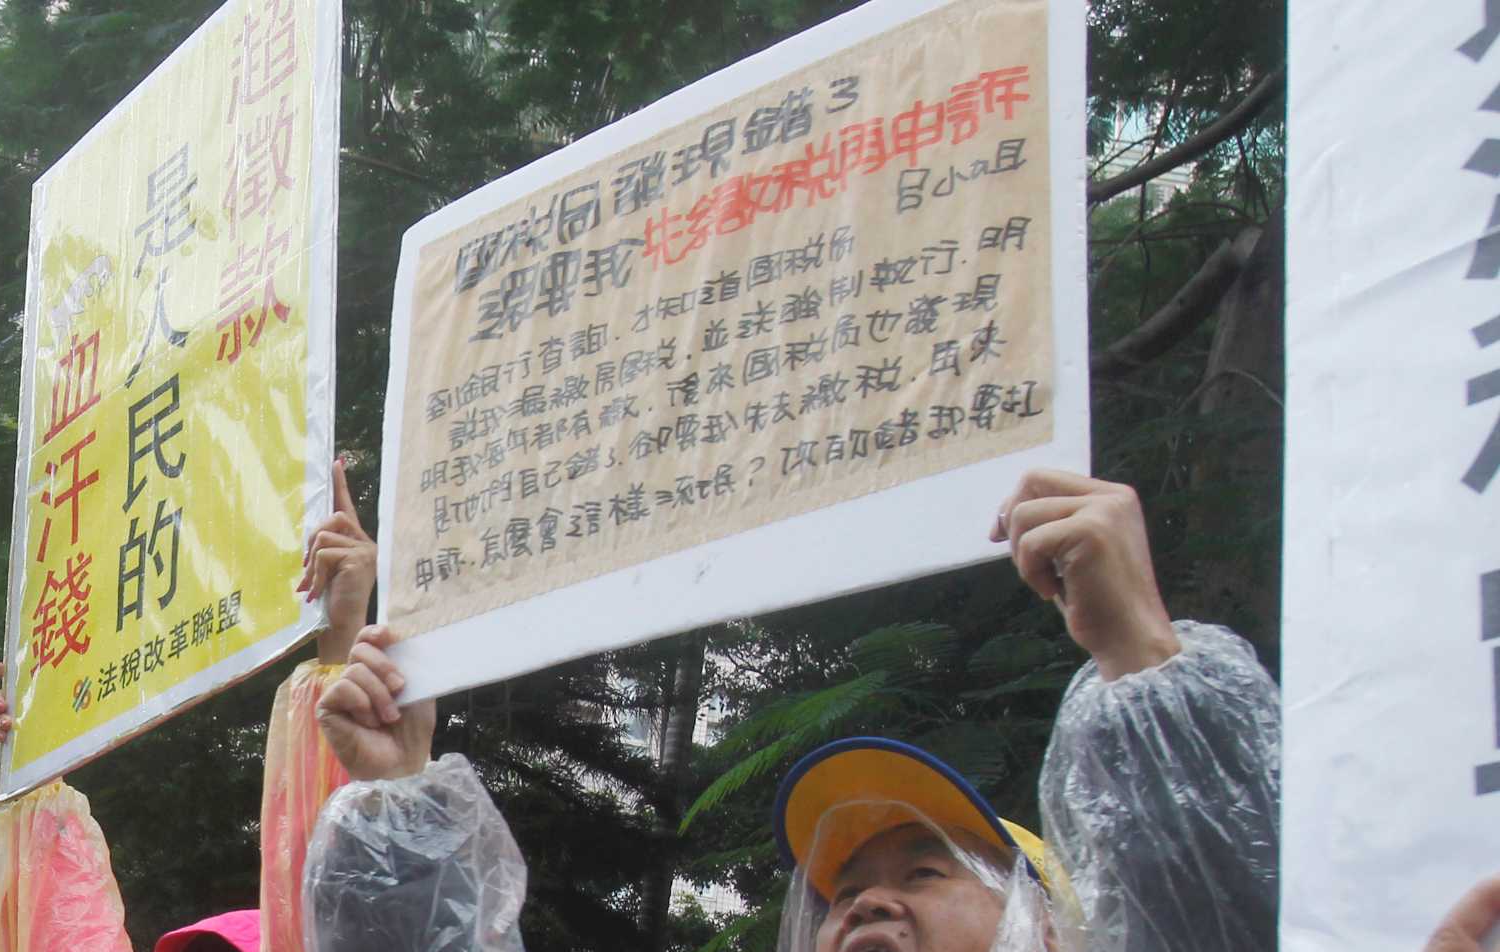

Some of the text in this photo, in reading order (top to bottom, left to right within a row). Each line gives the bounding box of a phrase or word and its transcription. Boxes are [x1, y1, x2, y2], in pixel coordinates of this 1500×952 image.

[30, 329, 101, 679] 血汗錢
[114, 140, 199, 634] 是人民的
[97, 589, 243, 702] 法稅改革聯盟
